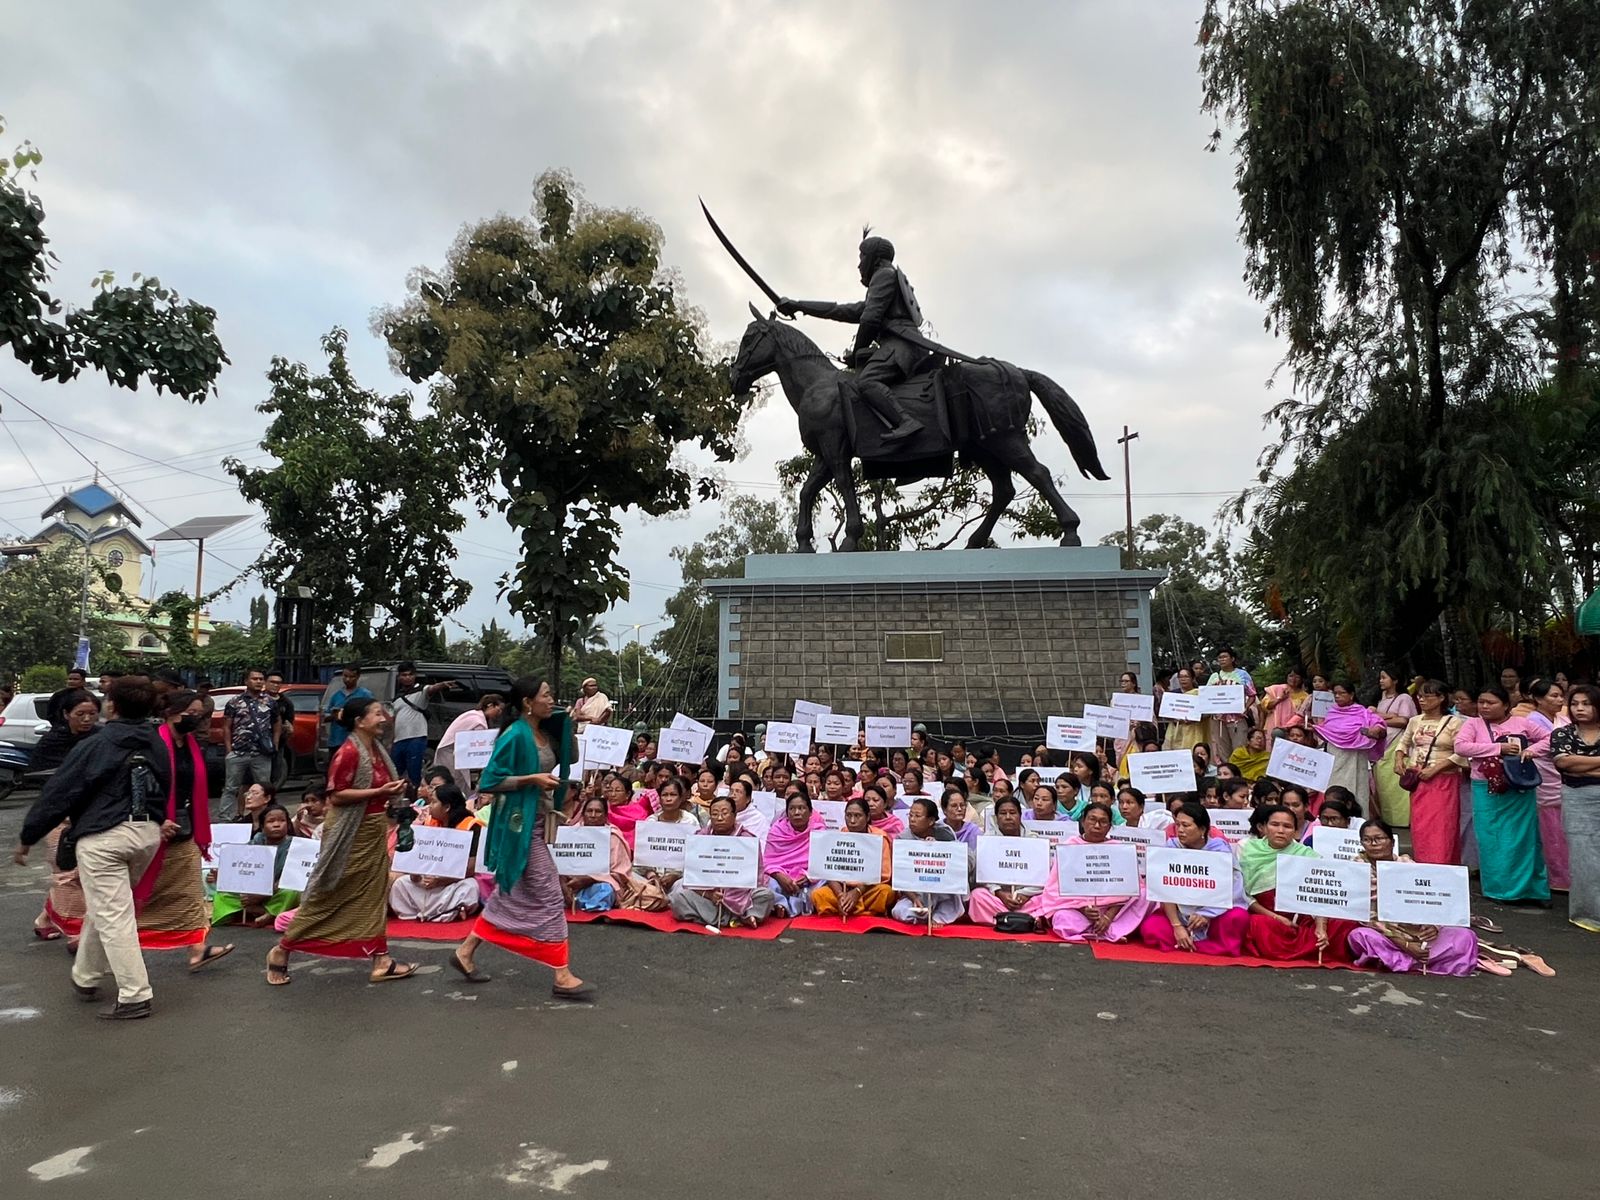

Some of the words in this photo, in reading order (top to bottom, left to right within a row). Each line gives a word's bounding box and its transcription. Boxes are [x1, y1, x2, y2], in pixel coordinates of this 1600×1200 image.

[436, 840, 464, 849] Women
[418, 853, 443, 862] United
[999, 862, 1028, 870] MANIPUR
[1169, 863, 1181, 873] NO
[1184, 865, 1209, 876] MORE
[1311, 868, 1335, 877] OPPOSE
[1163, 876, 1216, 889] BLOODSHED
[1304, 877, 1324, 885] CRUEL
[1325, 879, 1342, 887] ACTS
[1415, 878, 1431, 887] SAVE
[1299, 886, 1338, 896] REGARDLESS
[1309, 896, 1348, 907] COMMUNITY
